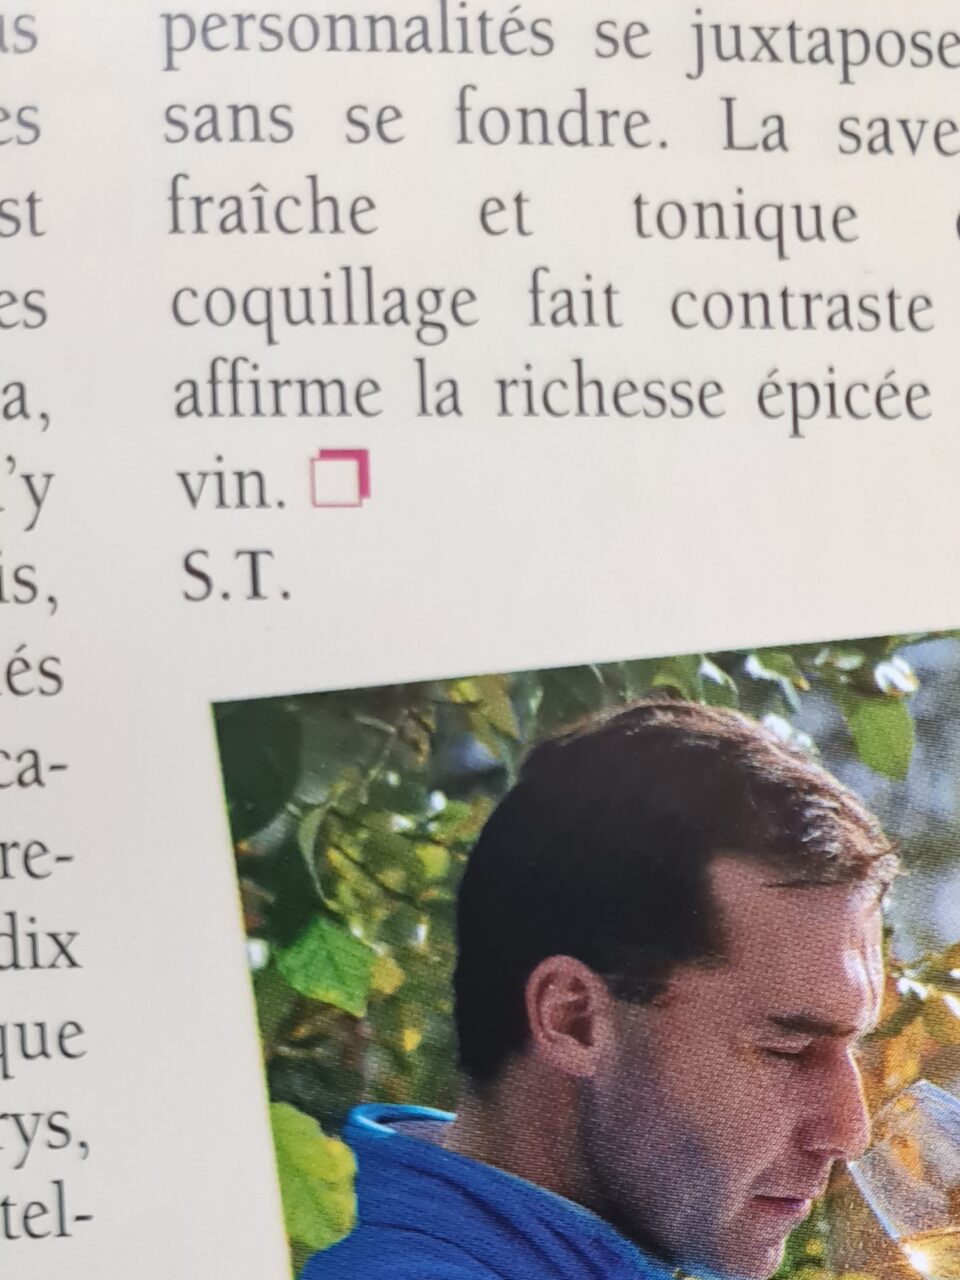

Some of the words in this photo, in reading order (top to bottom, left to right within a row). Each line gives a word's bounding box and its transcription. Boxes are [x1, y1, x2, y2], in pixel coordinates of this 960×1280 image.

[159, 0, 555, 72] personnalités
[595, 19, 652, 60] se
[164, 103, 294, 144] sans
[345, 104, 404, 145] se
[455, 83, 668, 149] fondre.
[719, 96, 789, 153] La
[0, 191, 46, 238] st
[167, 172, 378, 236] fraîche
[479, 191, 533, 237] et
[633, 187, 859, 261] tonique
[171, 265, 479, 347] coquillage
[528, 265, 623, 329] fait
[670, 285, 934, 333] contraste
[174, 355, 383, 419] affirme
[413, 356, 463, 418] la
[495, 357, 726, 419] richesse
[756, 366, 932, 439] épicée
[176, 454, 285, 509] vin.
[182, 548, 291, 603] S.T.
[0, 839, 74, 880] re-
[0, 910, 83, 972] dix
[0, 1179, 94, 1241] tel-
